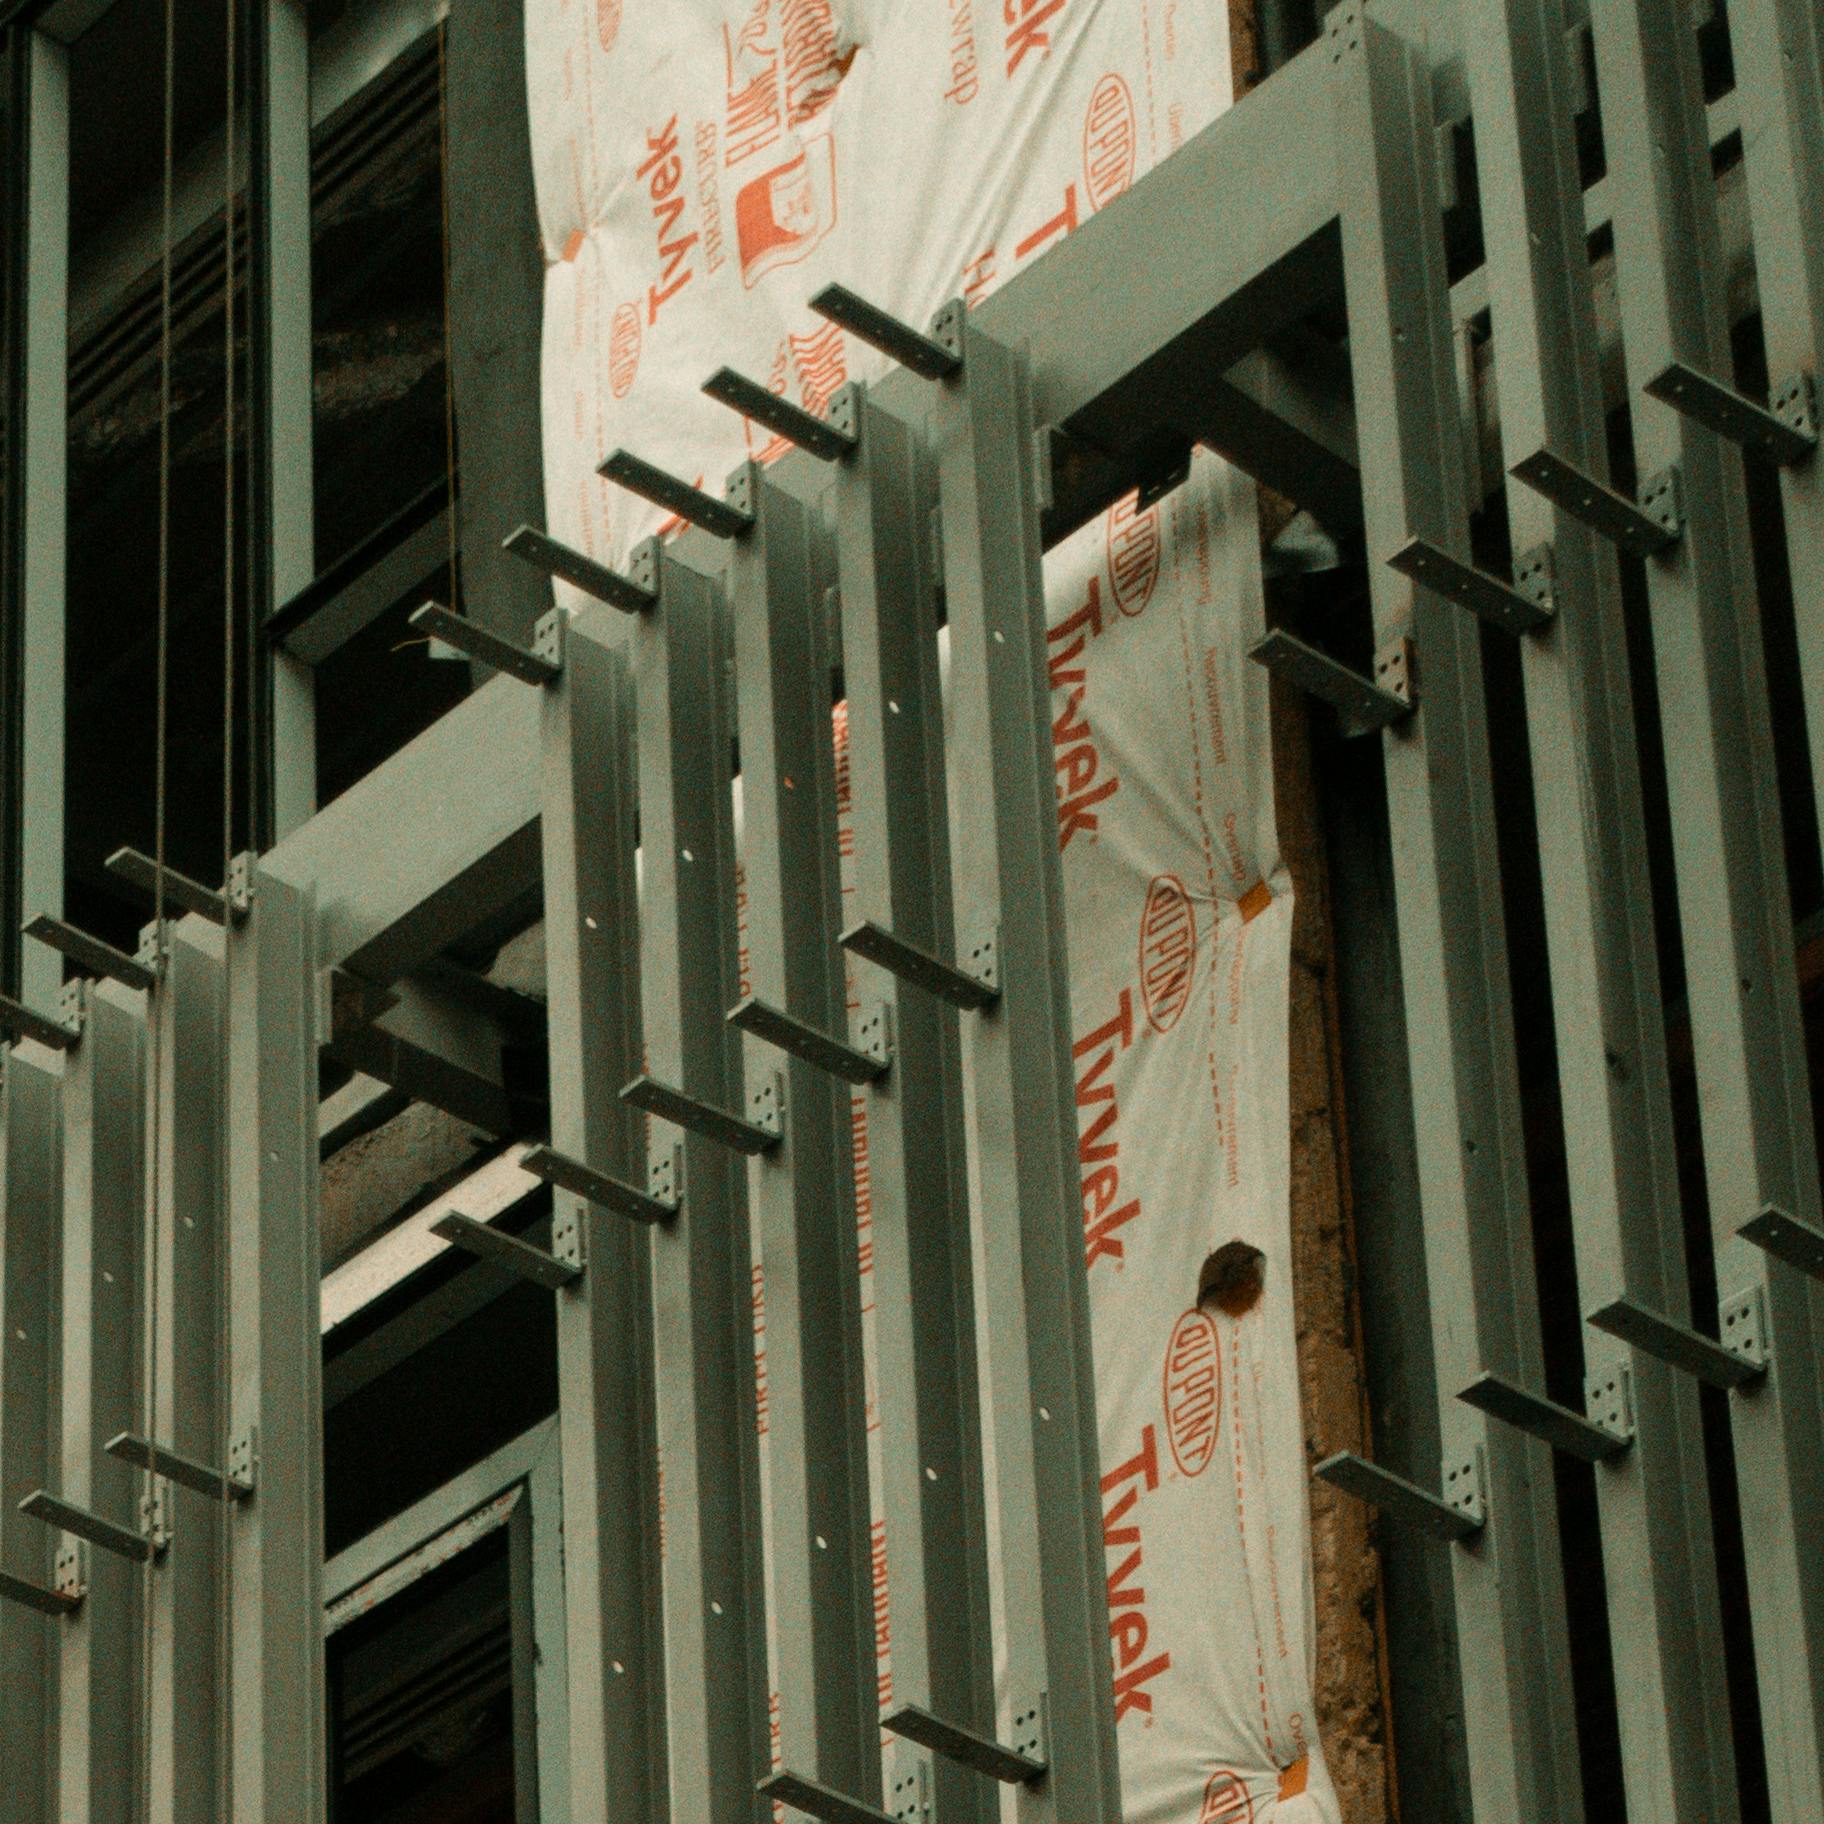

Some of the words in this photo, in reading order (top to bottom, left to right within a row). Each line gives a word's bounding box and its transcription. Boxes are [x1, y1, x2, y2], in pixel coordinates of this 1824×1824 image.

[635, 113, 699, 327] Tyvek
[1046, 575, 1120, 853] Tyvek
[1073, 986, 1142, 1275] Tyvek
[1100, 1422, 1172, 1729] Tyvek
